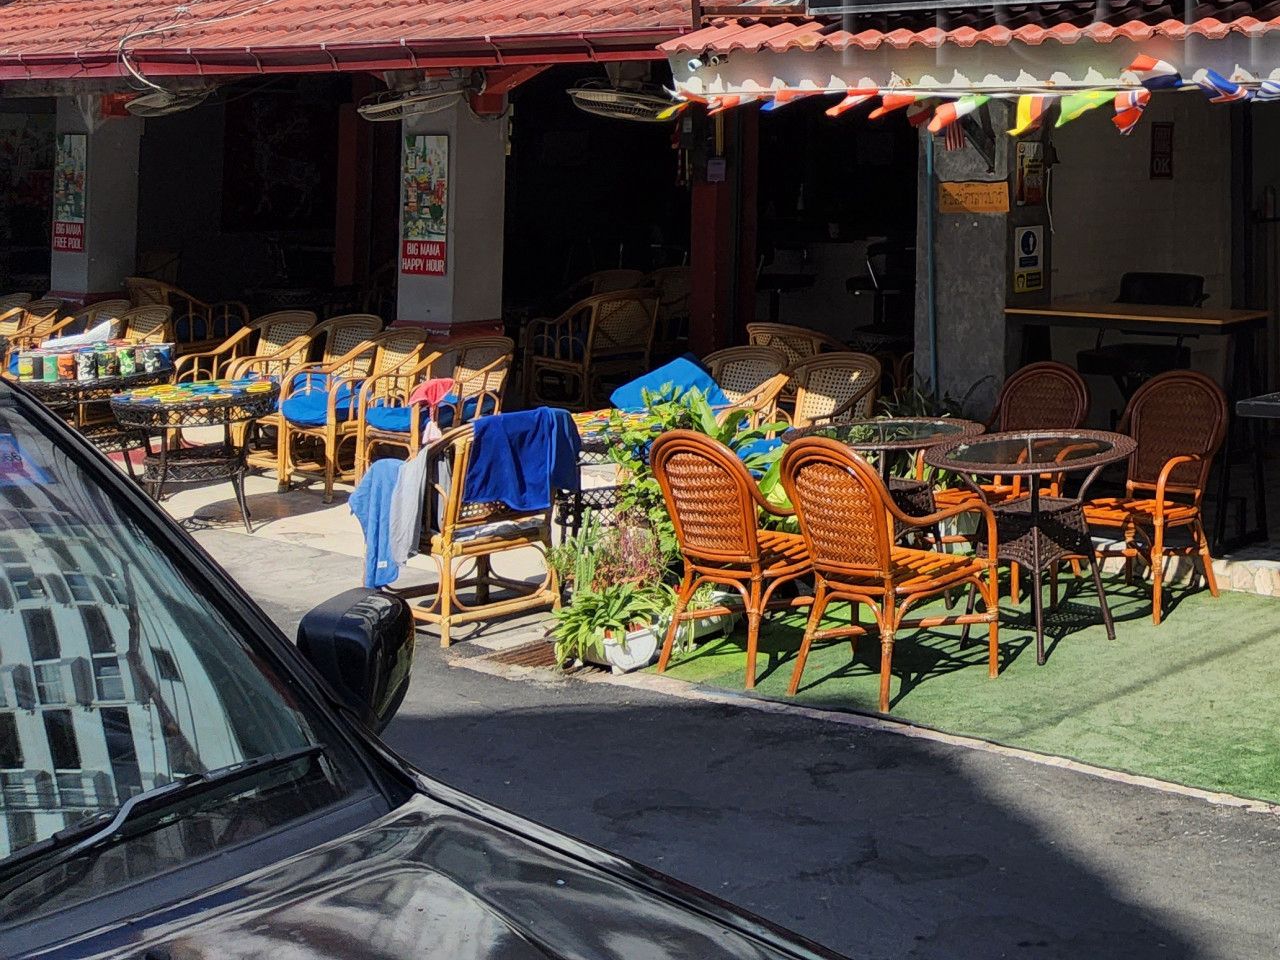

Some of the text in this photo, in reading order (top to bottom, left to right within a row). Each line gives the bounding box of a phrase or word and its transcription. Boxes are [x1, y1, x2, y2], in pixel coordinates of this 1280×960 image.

[54, 237, 83, 250] FREE POOL
[406, 243, 440, 256] BIG MAMA
[402, 258, 445, 272] HAPPY HOUR
